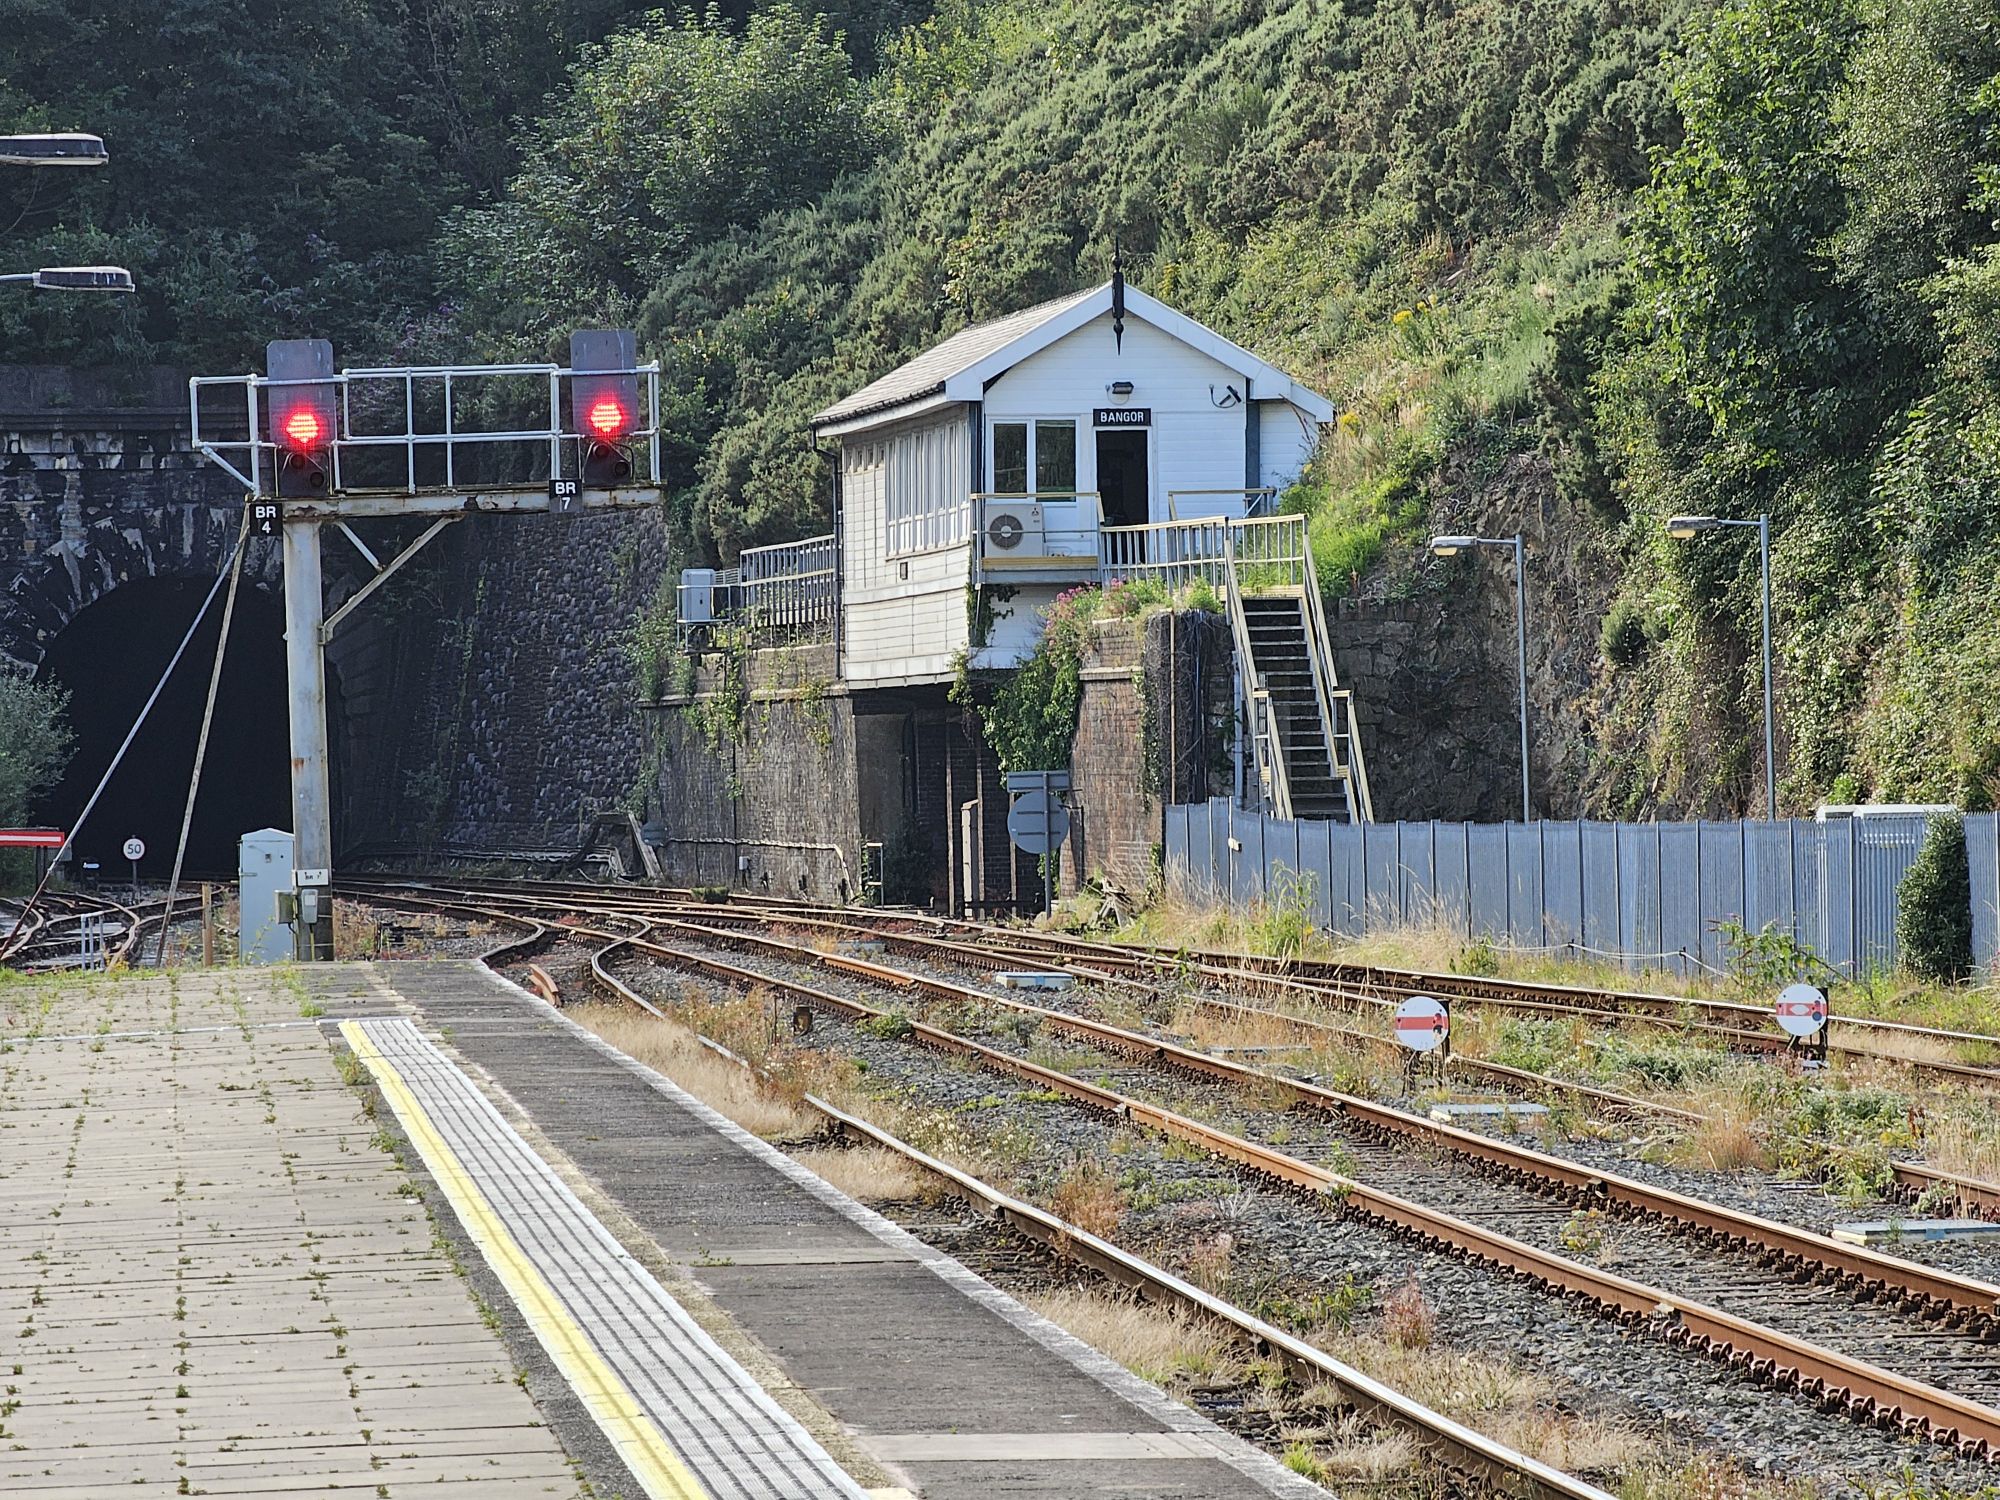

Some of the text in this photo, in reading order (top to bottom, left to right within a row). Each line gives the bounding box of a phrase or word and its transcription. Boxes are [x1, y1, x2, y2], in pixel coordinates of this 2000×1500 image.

[1100, 411, 1144, 423] BANGOR
[555, 481, 577, 495] BR
[562, 496, 571, 510] 7
[255, 505, 277, 519] BR
[261, 520, 272, 534] 4
[127, 843, 142, 855] 50
